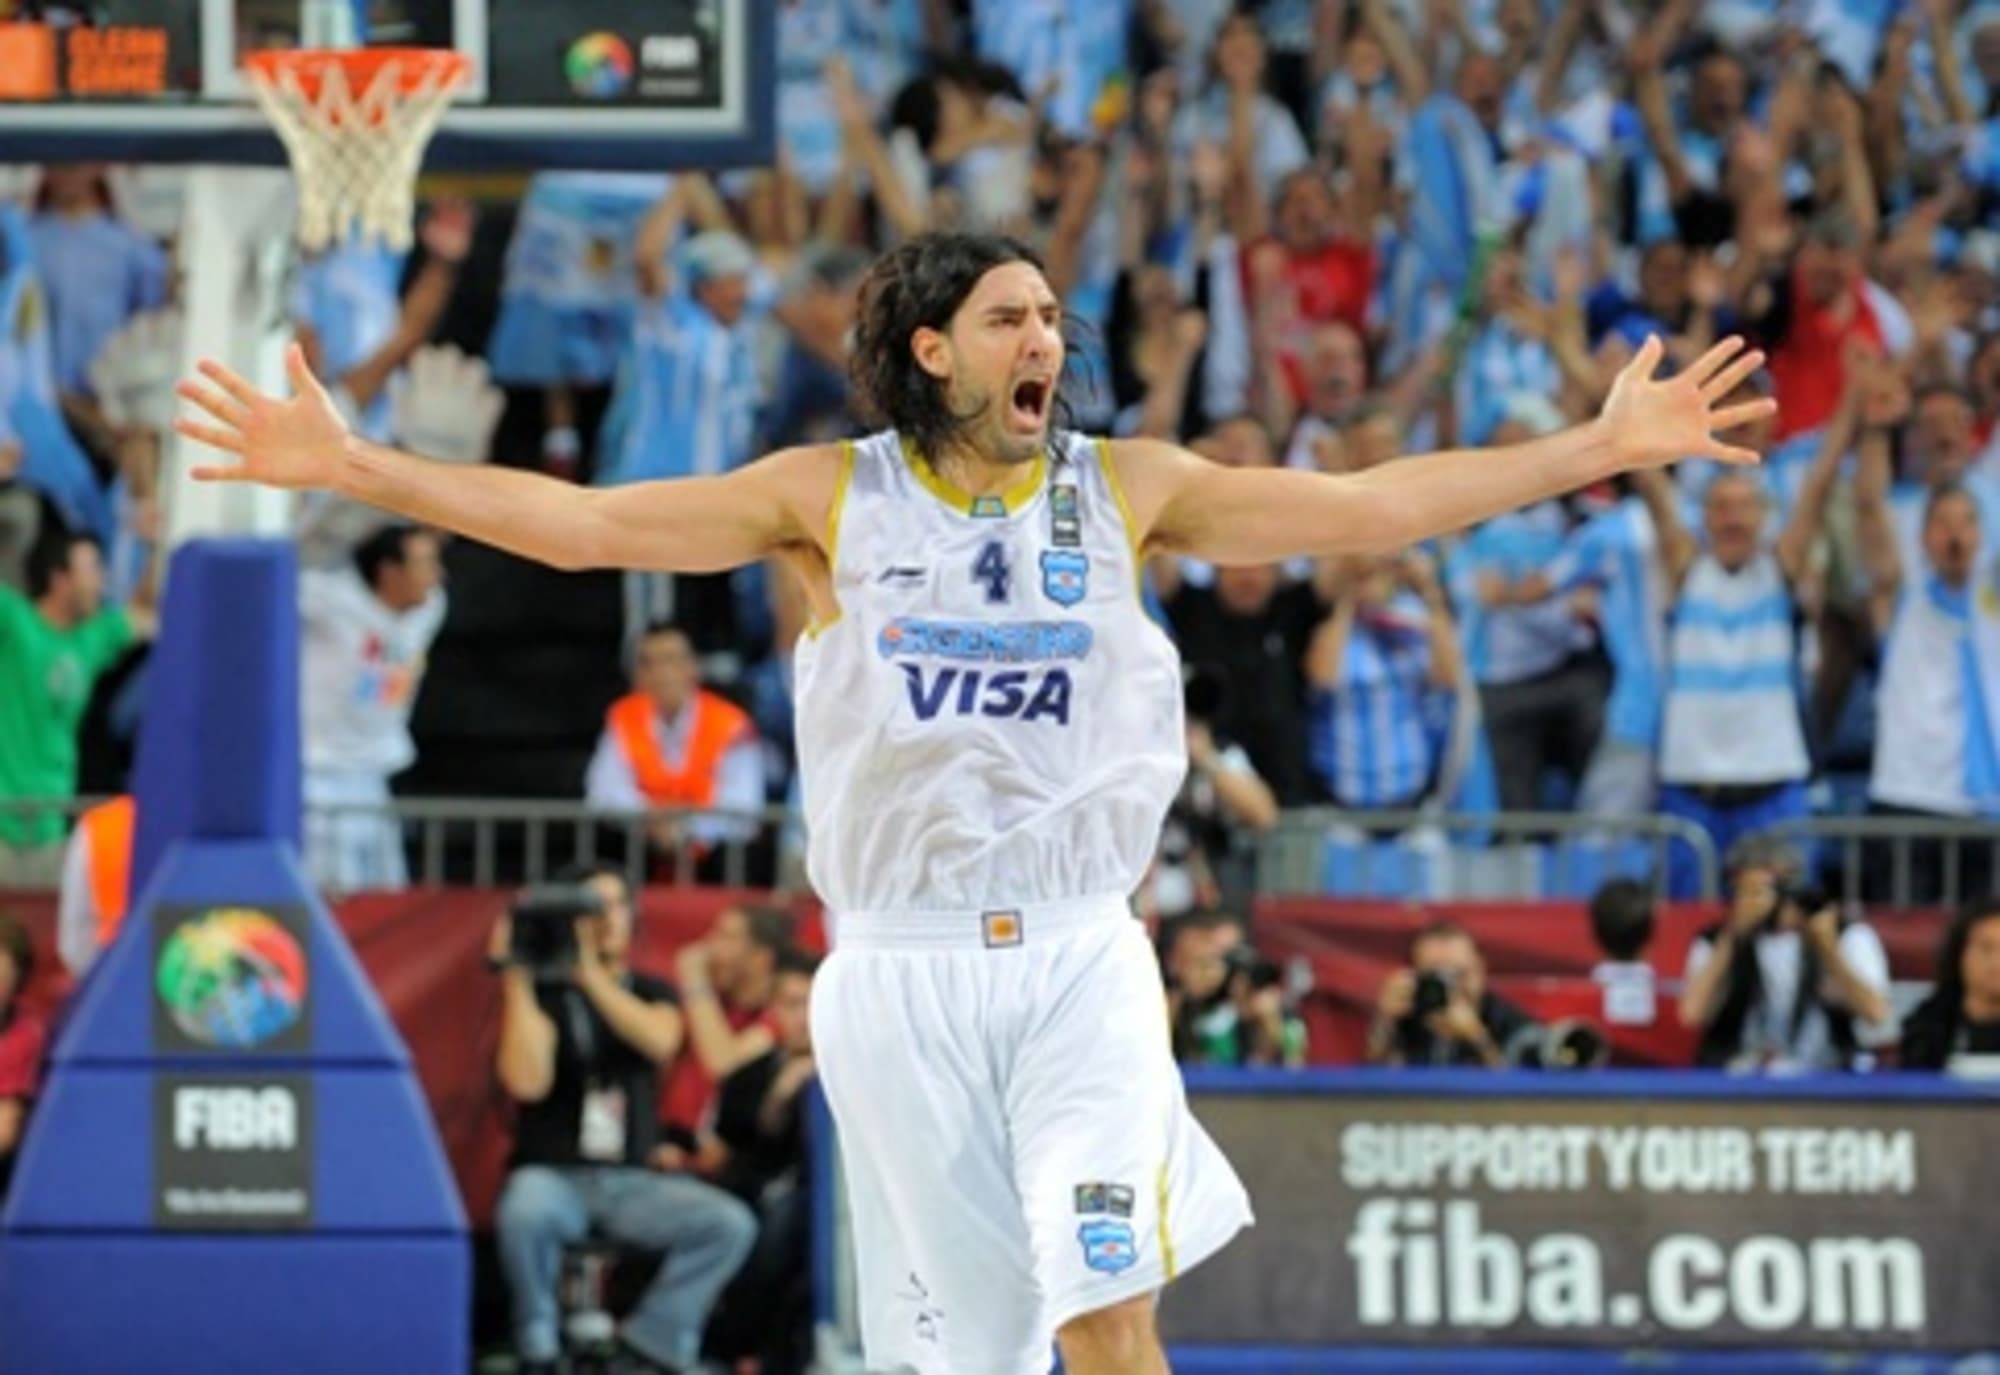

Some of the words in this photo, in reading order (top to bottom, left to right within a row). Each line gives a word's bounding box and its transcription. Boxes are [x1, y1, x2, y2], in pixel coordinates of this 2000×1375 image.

[971, 540, 1010, 604] 4
[897, 661, 1073, 726] VISA
[174, 1086, 297, 1150] FIBA
[1340, 1120, 1596, 1191] SUPPORT
[1598, 1124, 1754, 1193] YOUR
[1758, 1127, 1916, 1196] TEAM
[1345, 1198, 1928, 1331] fiba.com
